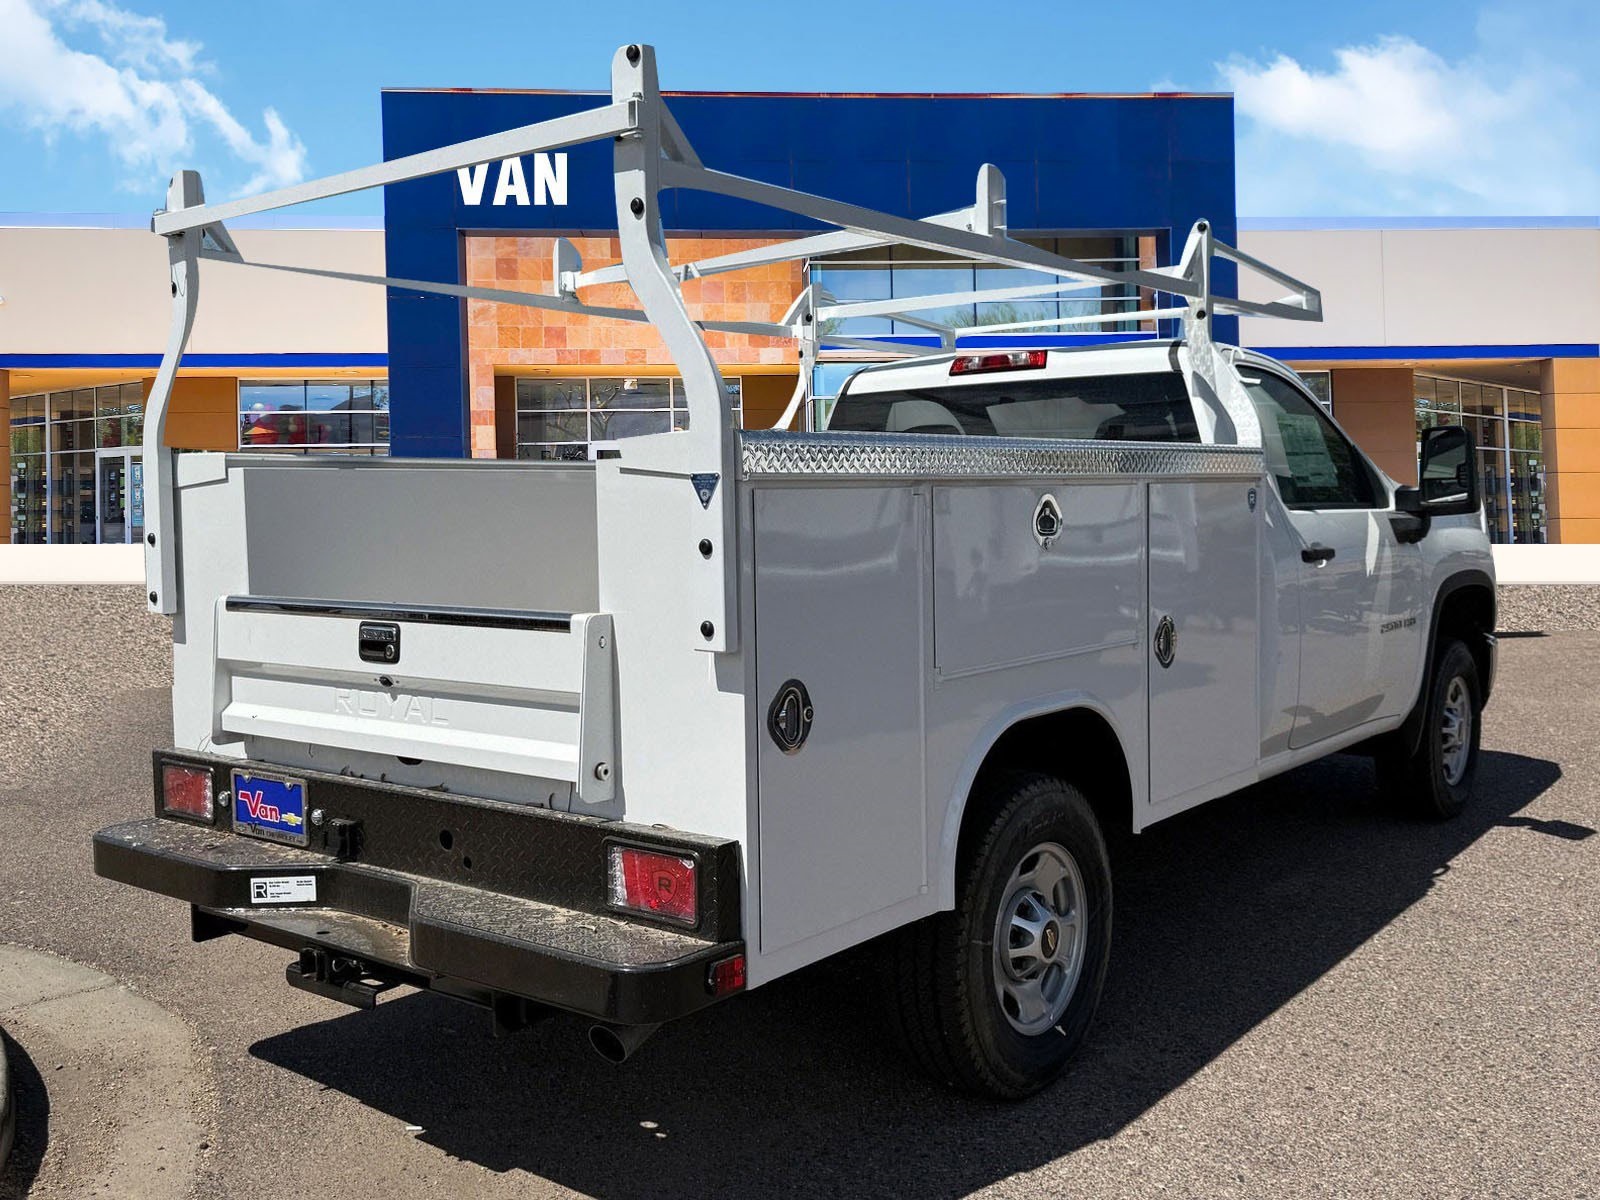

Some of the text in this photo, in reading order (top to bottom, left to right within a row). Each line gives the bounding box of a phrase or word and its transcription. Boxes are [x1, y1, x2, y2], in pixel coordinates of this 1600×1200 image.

[456, 152, 568, 206] VAN
[335, 687, 449, 724] ROYAL
[239, 790, 280, 823] Van
[253, 882, 268, 898] R
[658, 877, 671, 893] R
